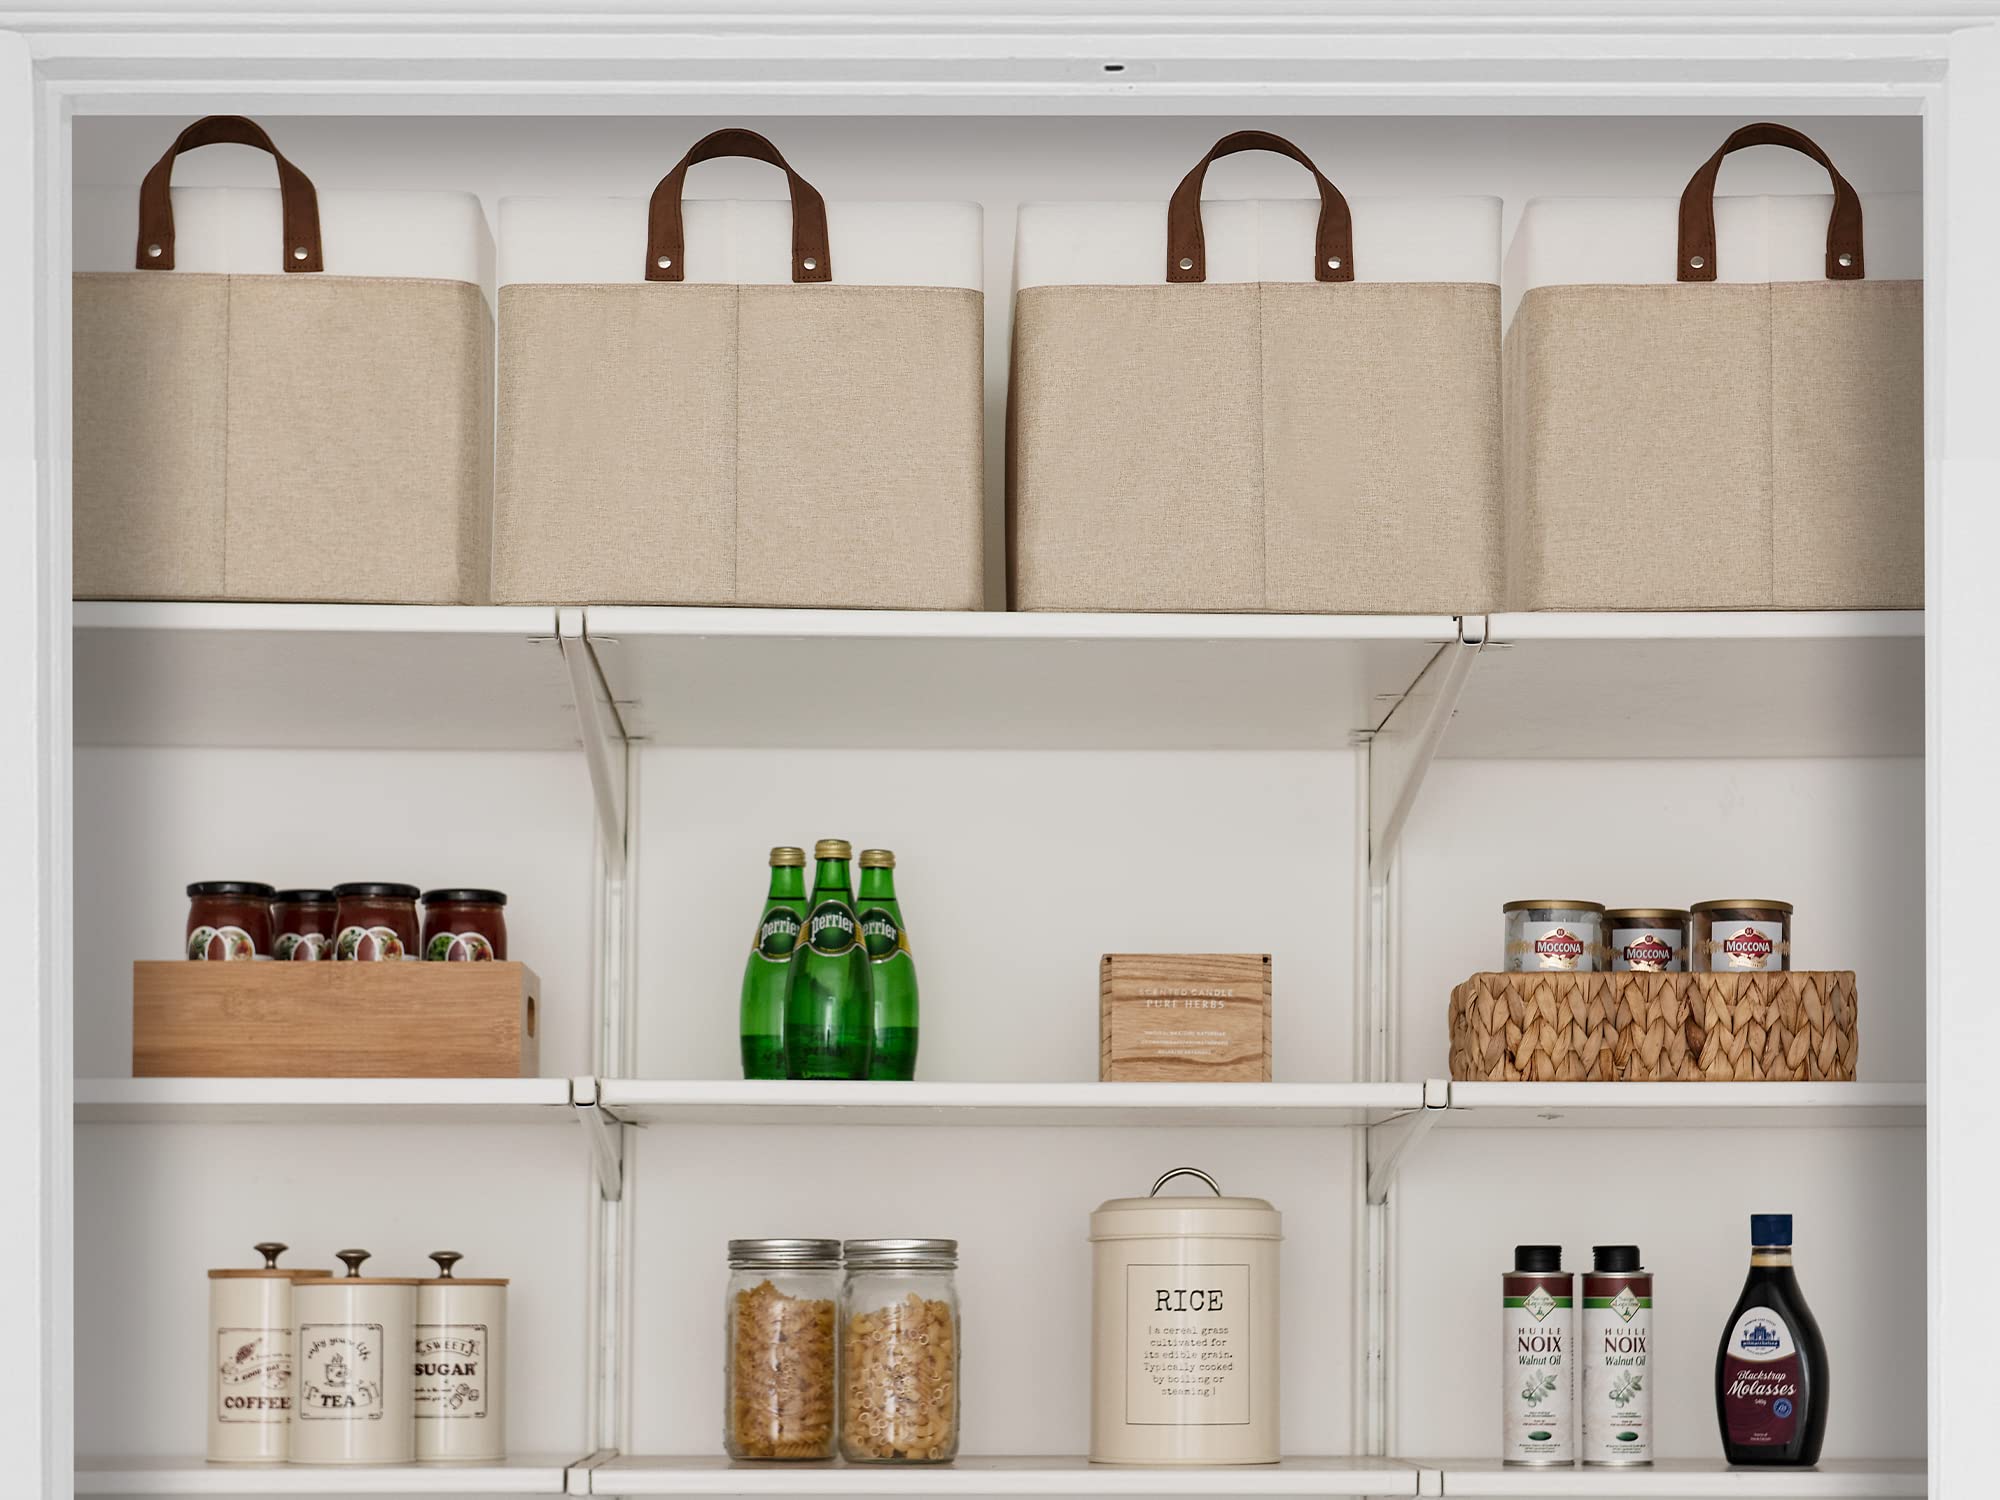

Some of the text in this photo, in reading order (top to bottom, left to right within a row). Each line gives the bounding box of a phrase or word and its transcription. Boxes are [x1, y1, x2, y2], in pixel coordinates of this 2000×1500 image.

[811, 912, 854, 943] perrier
[863, 919, 897, 941] errier
[1191, 988, 1233, 997] CANDLE
[1146, 999, 1225, 1009] PURE HERBS
[1155, 1289, 1224, 1311] RICE
[1163, 1326, 1198, 1335] cereal
[1201, 1327, 1229, 1336] grass
[1518, 1327, 1562, 1335] HUILE
[1605, 1328, 1646, 1336] HUILE
[1150, 1338, 1227, 1347] cultivated for
[1518, 1336, 1562, 1352] NOIX
[1604, 1336, 1646, 1353] NOIX
[1143, 1350, 1233, 1360] its edible grain.
[1518, 1354, 1562, 1366] Walnut Oil
[1605, 1355, 1646, 1366] Walnut Oil
[415, 1363, 476, 1376] SUGAR
[1143, 1361, 1233, 1373] Typically cooked
[1152, 1374, 1225, 1385] by boiling or
[1737, 1370, 1787, 1383] Blackstrap
[1726, 1380, 1797, 1399] Molasses
[224, 1396, 292, 1409] COFFEE
[320, 1394, 356, 1408] TEA
